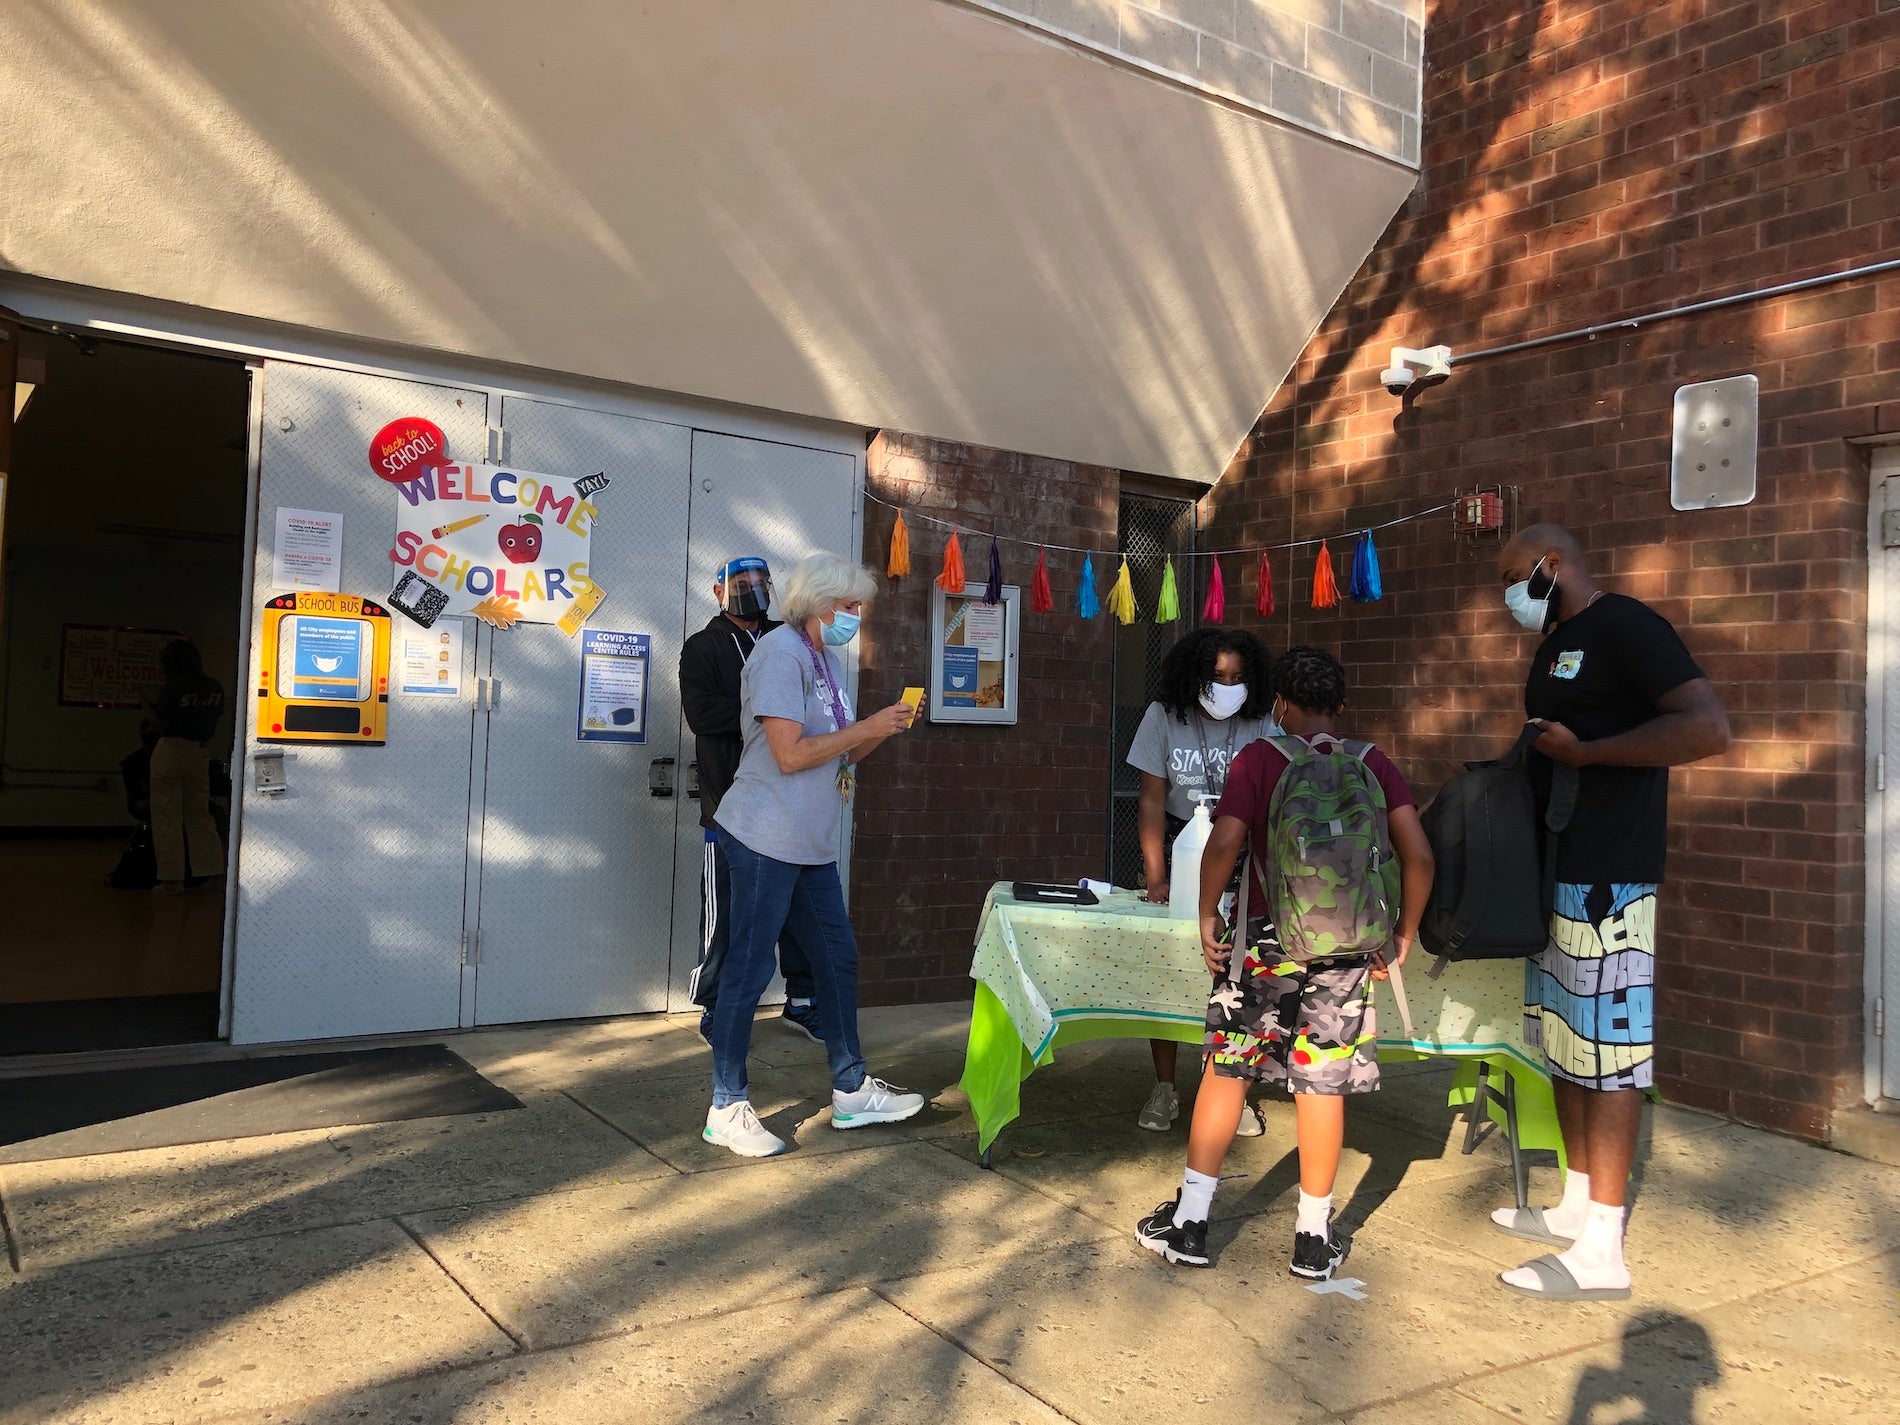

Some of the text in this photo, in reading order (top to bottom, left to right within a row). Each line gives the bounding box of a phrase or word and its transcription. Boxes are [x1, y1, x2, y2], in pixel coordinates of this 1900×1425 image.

[382, 429, 419, 456] back to
[382, 432, 438, 475] SCHOOL!
[577, 474, 605, 495] YAY!
[393, 466, 600, 538] WELCOME
[388, 531, 592, 602] SCHOLARS
[298, 598, 359, 613] SCHOOL BUS
[571, 604, 587, 620] YOU
[587, 641, 621, 649] LEARNING
[597, 633, 638, 644] COVID-19
